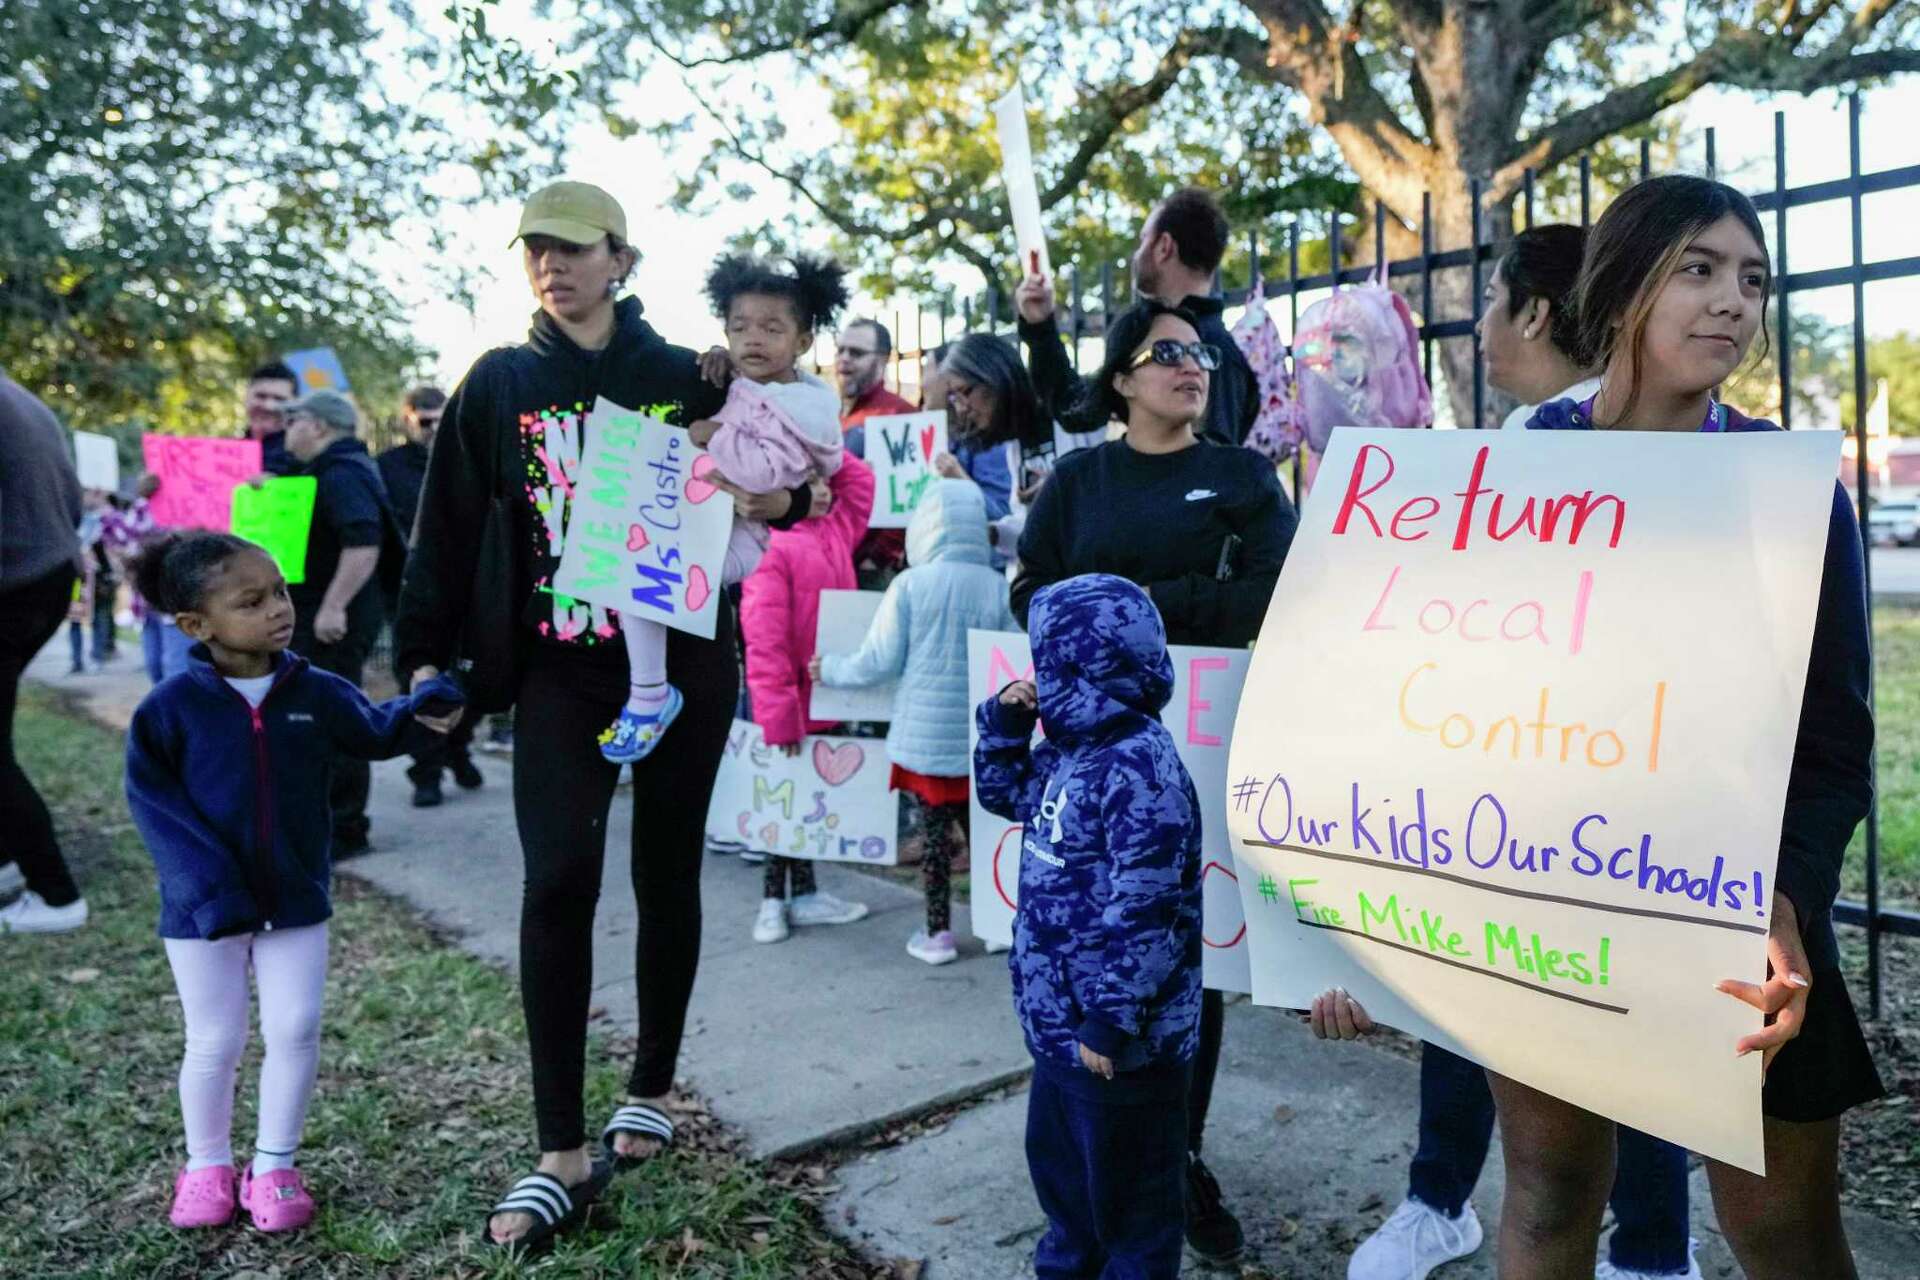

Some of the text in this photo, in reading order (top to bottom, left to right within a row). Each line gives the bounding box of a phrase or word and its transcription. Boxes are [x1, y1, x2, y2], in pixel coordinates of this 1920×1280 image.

[588, 414, 642, 508] MISS
[638, 436, 682, 530] Castro
[881, 422, 917, 467] We
[1331, 444, 1626, 551] Return
[573, 521, 626, 590] WE
[1362, 566, 1594, 655] Local
[1399, 662, 1666, 773] Control
[1485, 920, 1611, 986] Miles!
